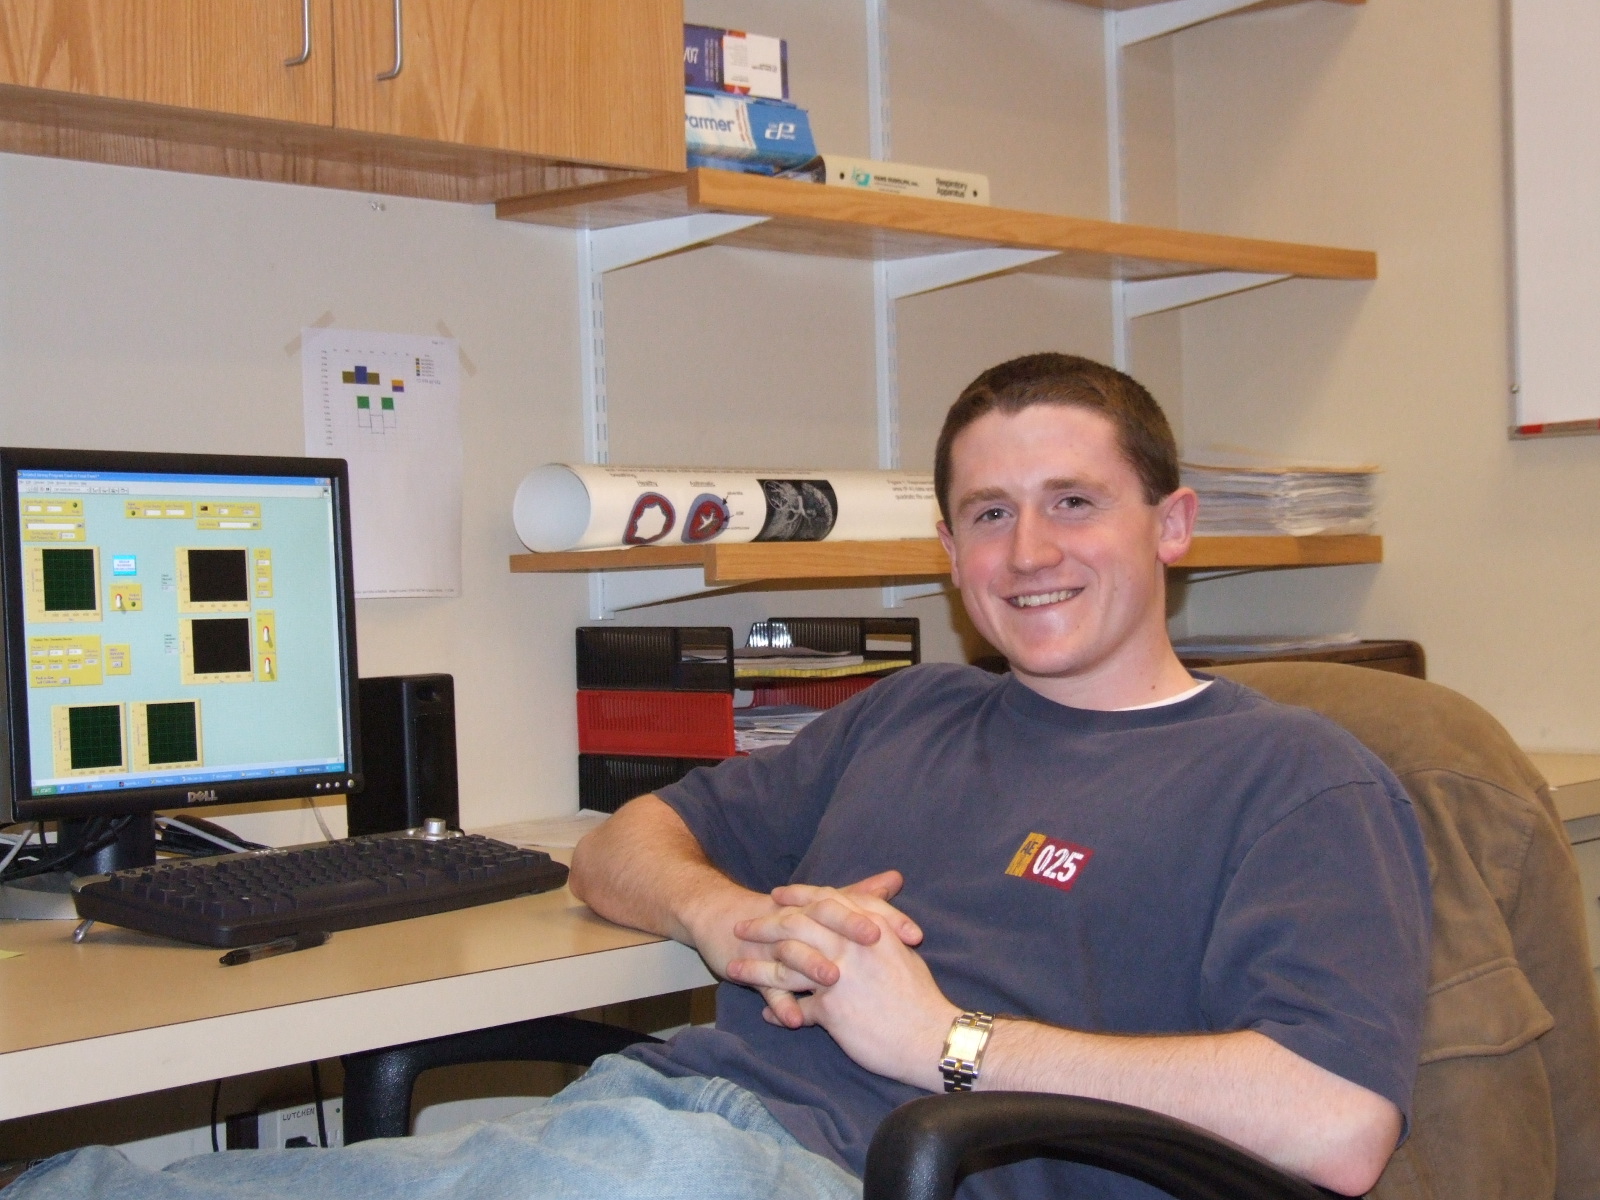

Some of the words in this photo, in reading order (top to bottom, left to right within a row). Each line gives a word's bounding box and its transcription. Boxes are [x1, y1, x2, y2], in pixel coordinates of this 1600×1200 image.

[685, 113, 735, 132] armer
[936, 178, 968, 191] Respiratory
[937, 187, 965, 198] Apparatus
[188, 790, 218, 802] DELL
[1032, 844, 1084, 882] 025
